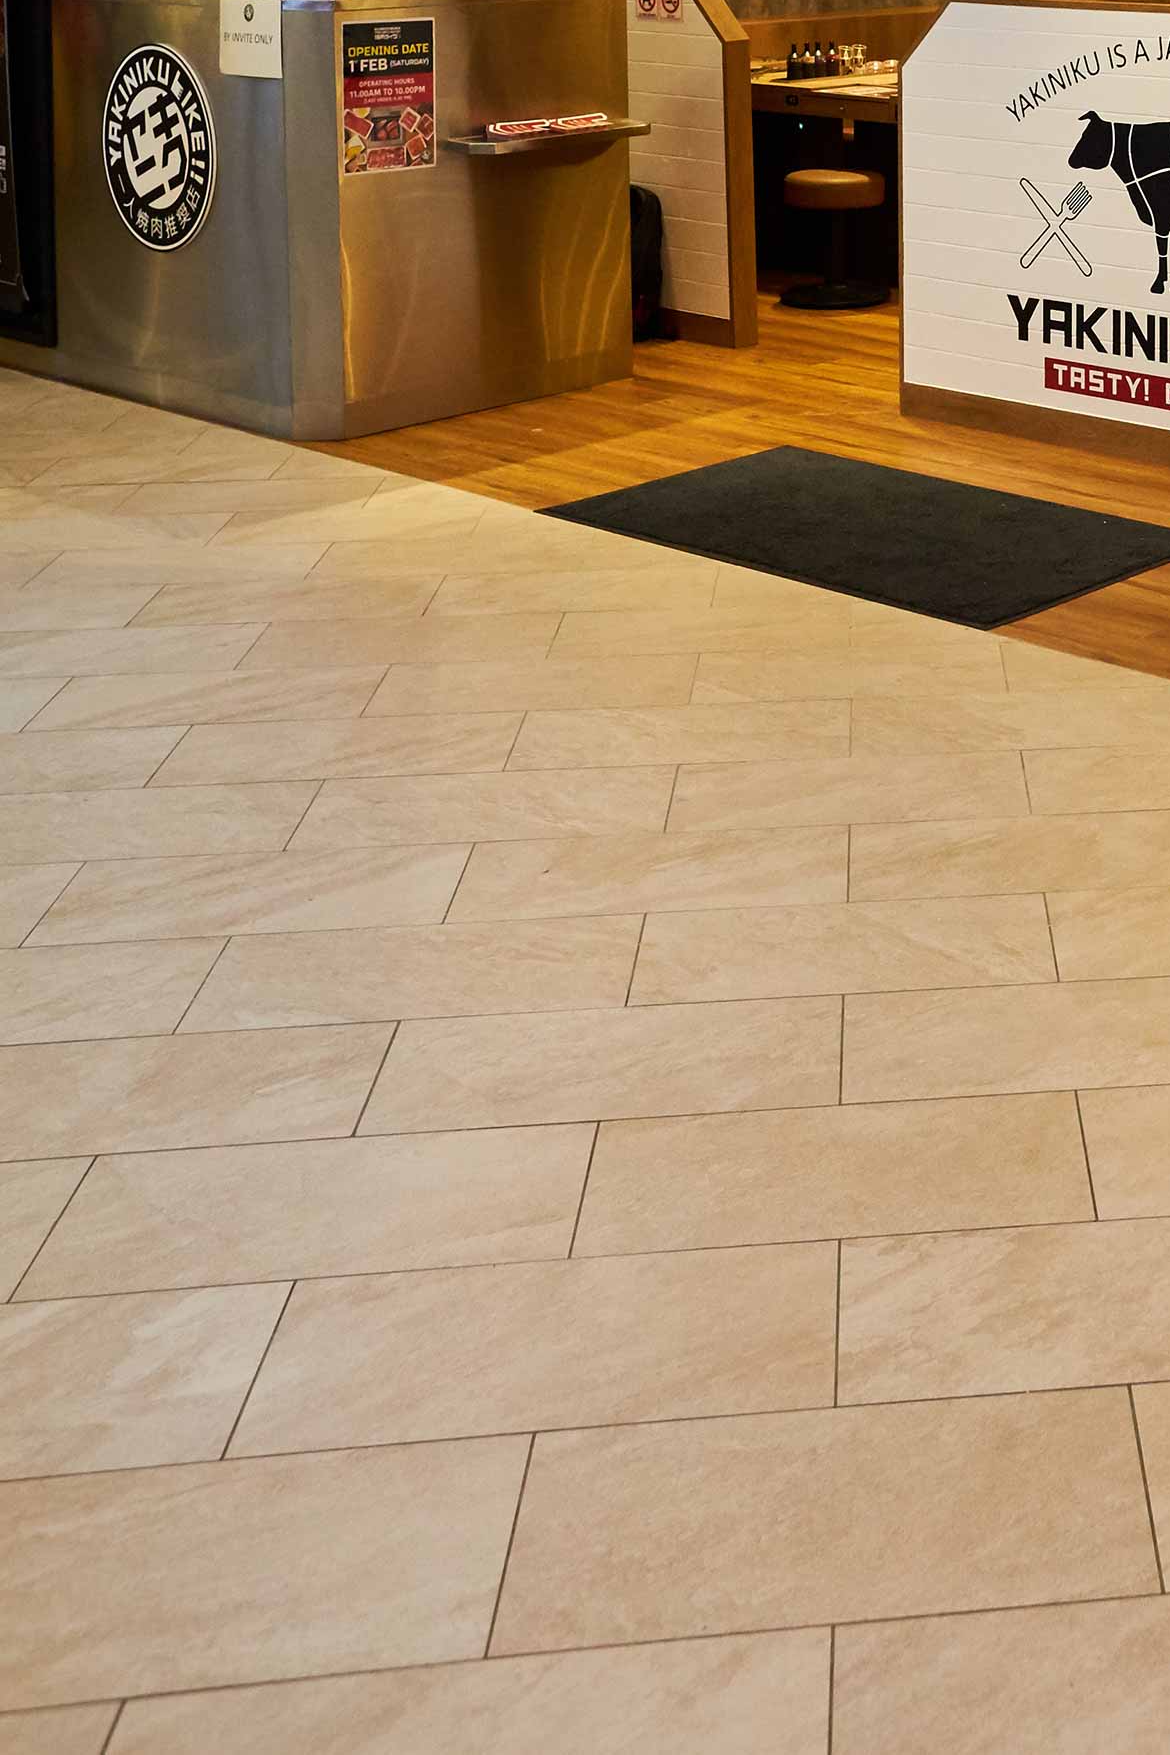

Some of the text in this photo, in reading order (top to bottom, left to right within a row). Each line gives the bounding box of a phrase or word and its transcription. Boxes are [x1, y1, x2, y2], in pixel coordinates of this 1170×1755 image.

[232, 32, 253, 43] INVITE
[254, 35, 273, 45] ONLY
[348, 43, 429, 57] OPENING DATE
[360, 58, 388, 72] FEB
[390, 58, 429, 68] (SATURDAY)
[359, 77, 415, 87] OPERATING HOURS
[1006, 51, 1100, 122] YAKINIKU
[1107, 43, 1127, 70] IS
[1134, 39, 1150, 65] A
[383, 87, 393, 96] TO
[108, 57, 170, 166] YAKINIKU
[1053, 364, 1149, 401] TASTY!
